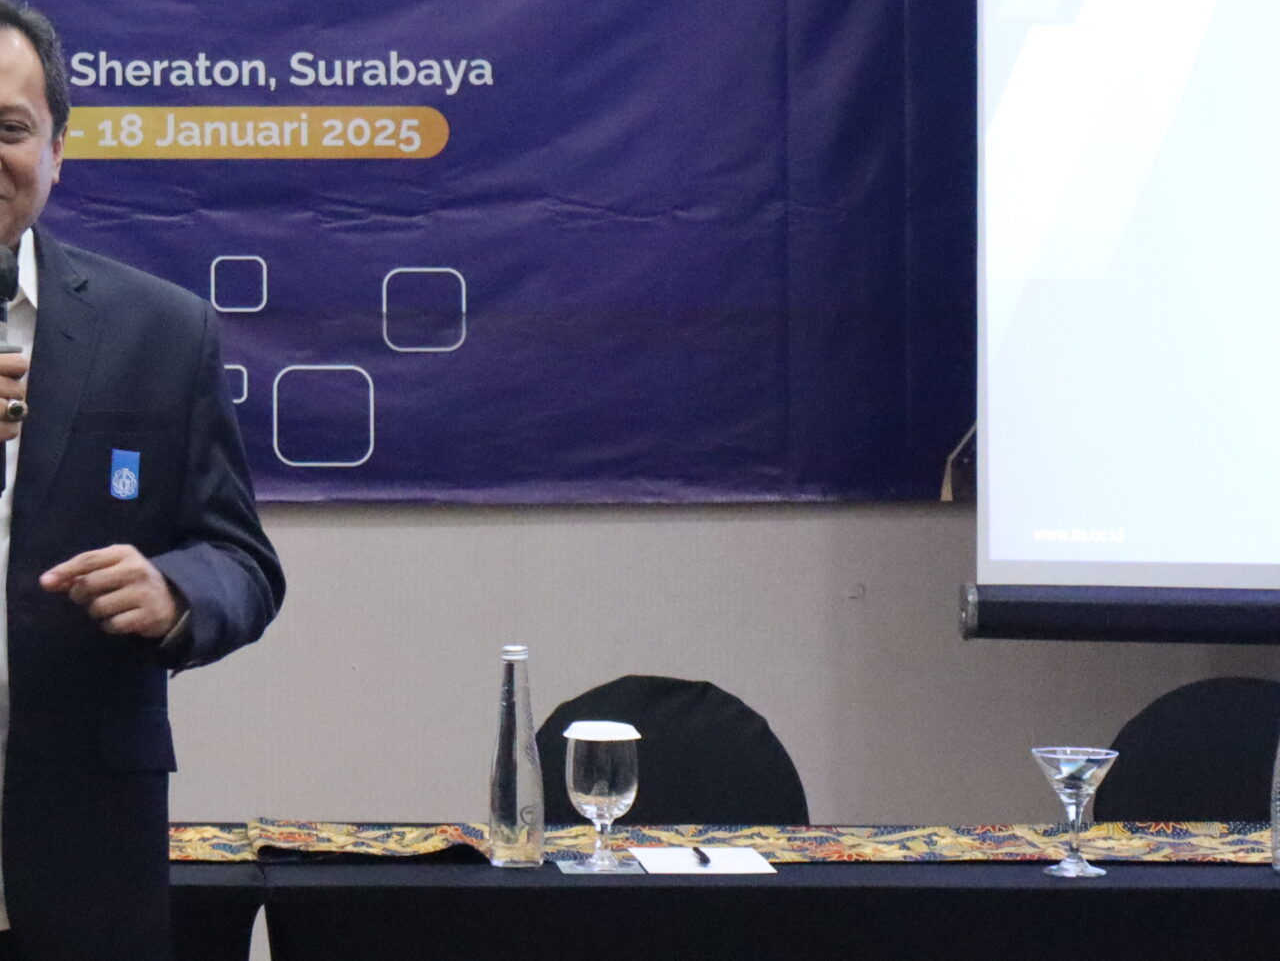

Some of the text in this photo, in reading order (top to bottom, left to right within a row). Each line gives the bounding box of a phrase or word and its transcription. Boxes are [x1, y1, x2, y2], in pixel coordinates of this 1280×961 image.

[70, 50, 494, 96] Sheraton, Surabaya
[98, 113, 144, 147] 18
[155, 112, 309, 147] Januari
[321, 117, 421, 152] 2025
